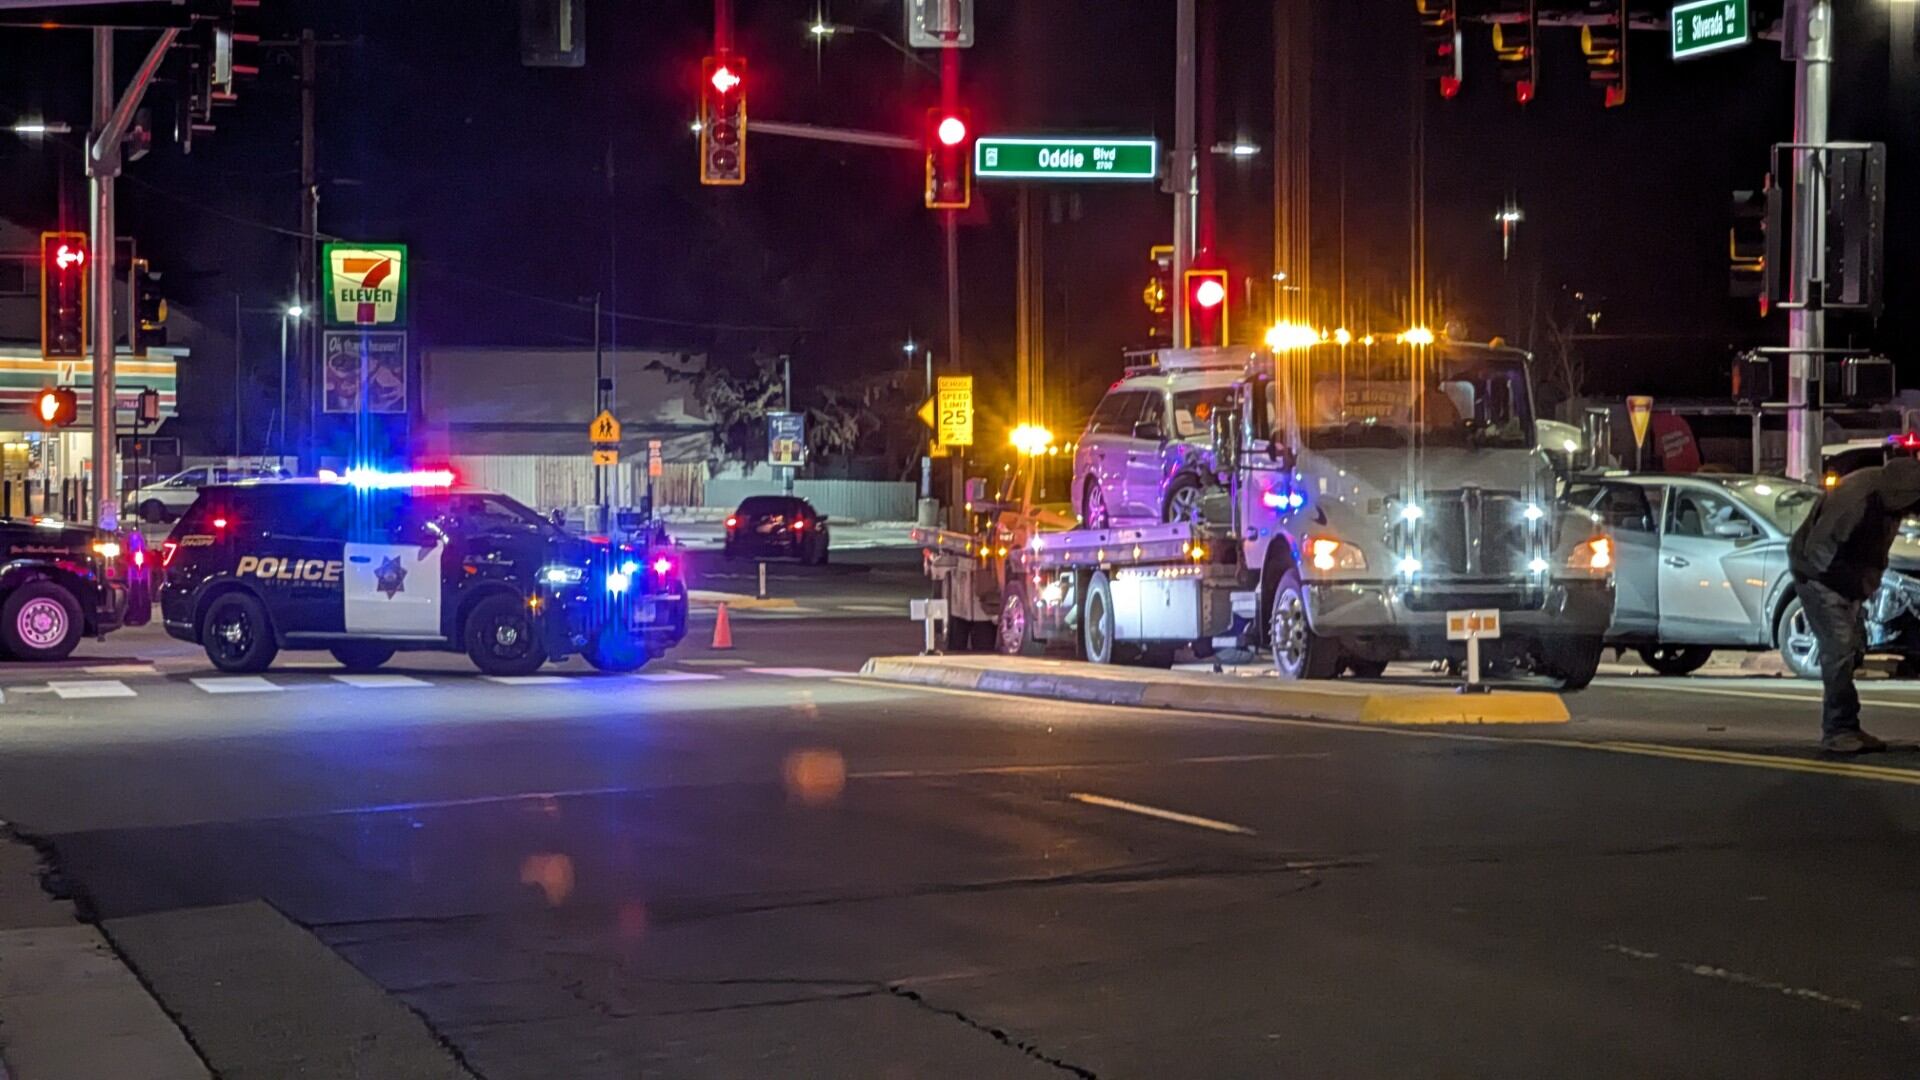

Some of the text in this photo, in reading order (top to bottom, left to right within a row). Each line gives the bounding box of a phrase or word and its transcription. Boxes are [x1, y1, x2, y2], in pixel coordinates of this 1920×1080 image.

[1692, 10, 1723, 41] Silverada
[1038, 147, 1116, 168] Oddie Blvd
[942, 410, 967, 425] 25
[236, 556, 342, 581] POLICE
